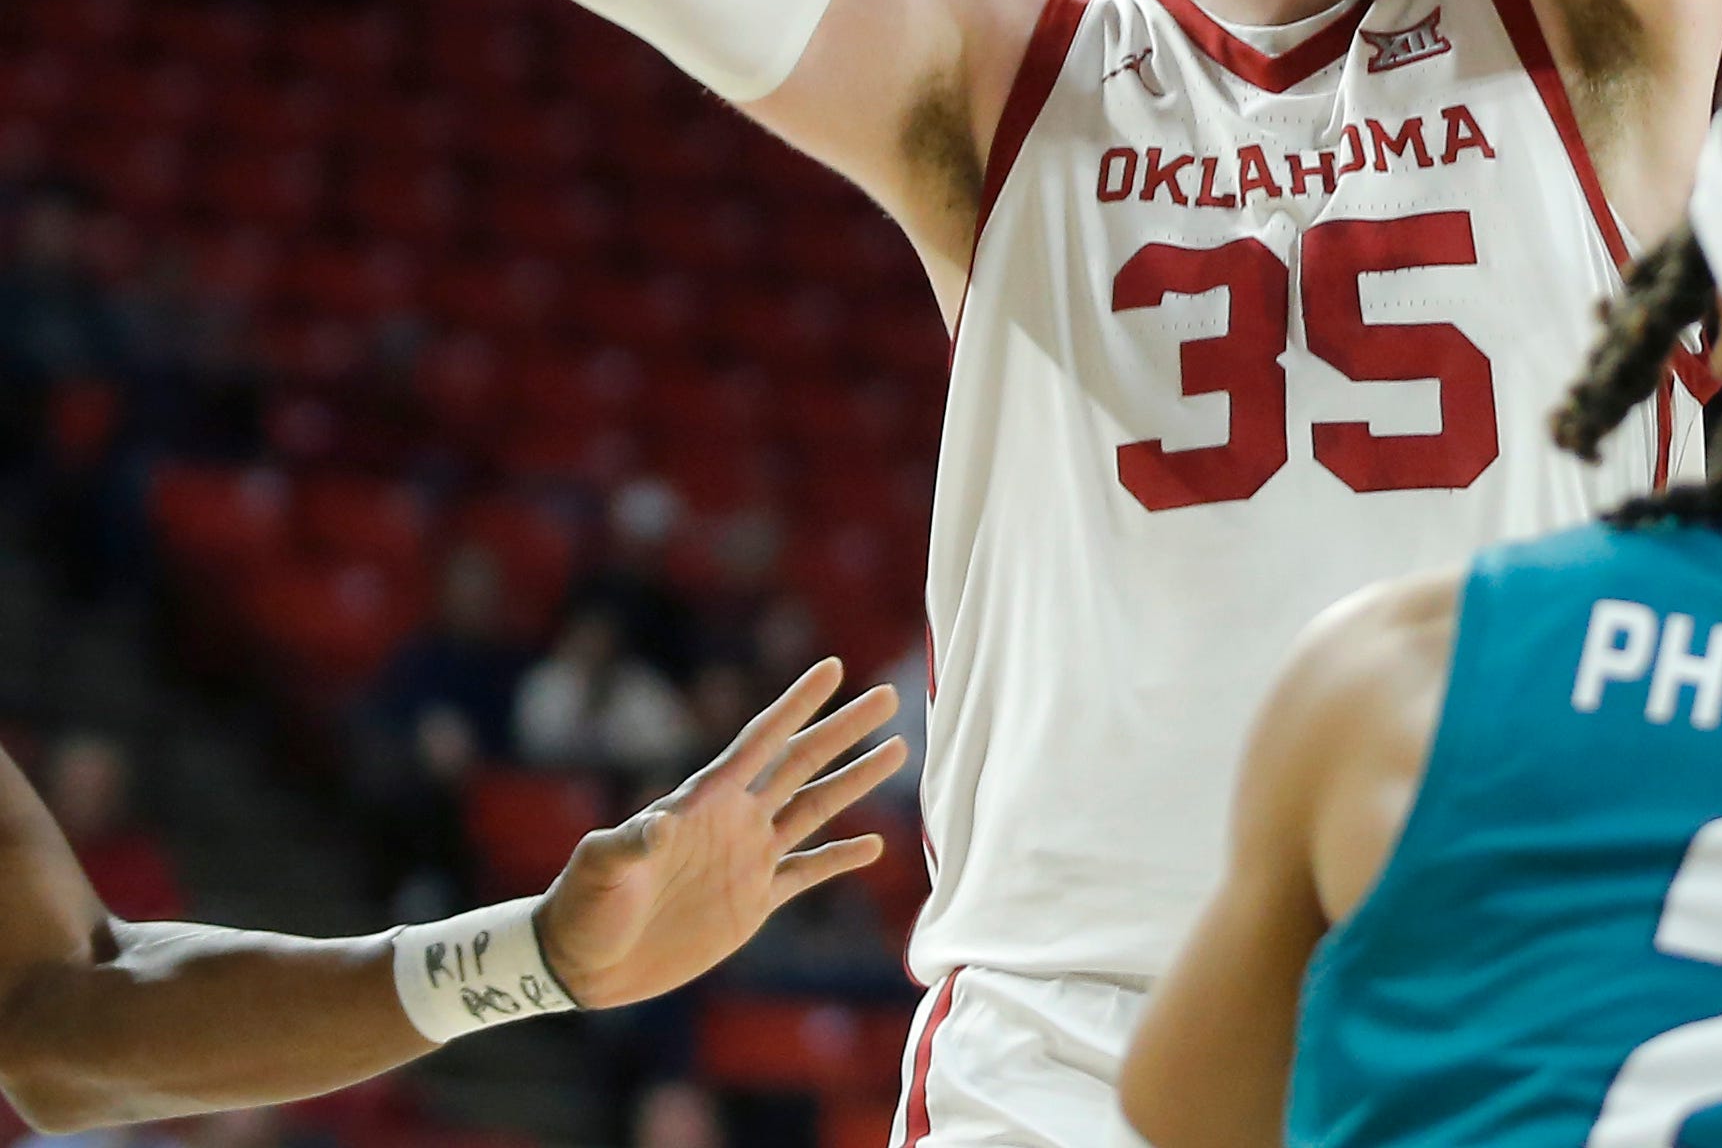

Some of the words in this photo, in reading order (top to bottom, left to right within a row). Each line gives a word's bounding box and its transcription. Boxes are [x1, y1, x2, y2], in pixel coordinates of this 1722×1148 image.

[1096, 104, 1496, 208] OKLAHOMA
[1111, 210, 1501, 512] 35
[424, 930, 490, 988] RIP
